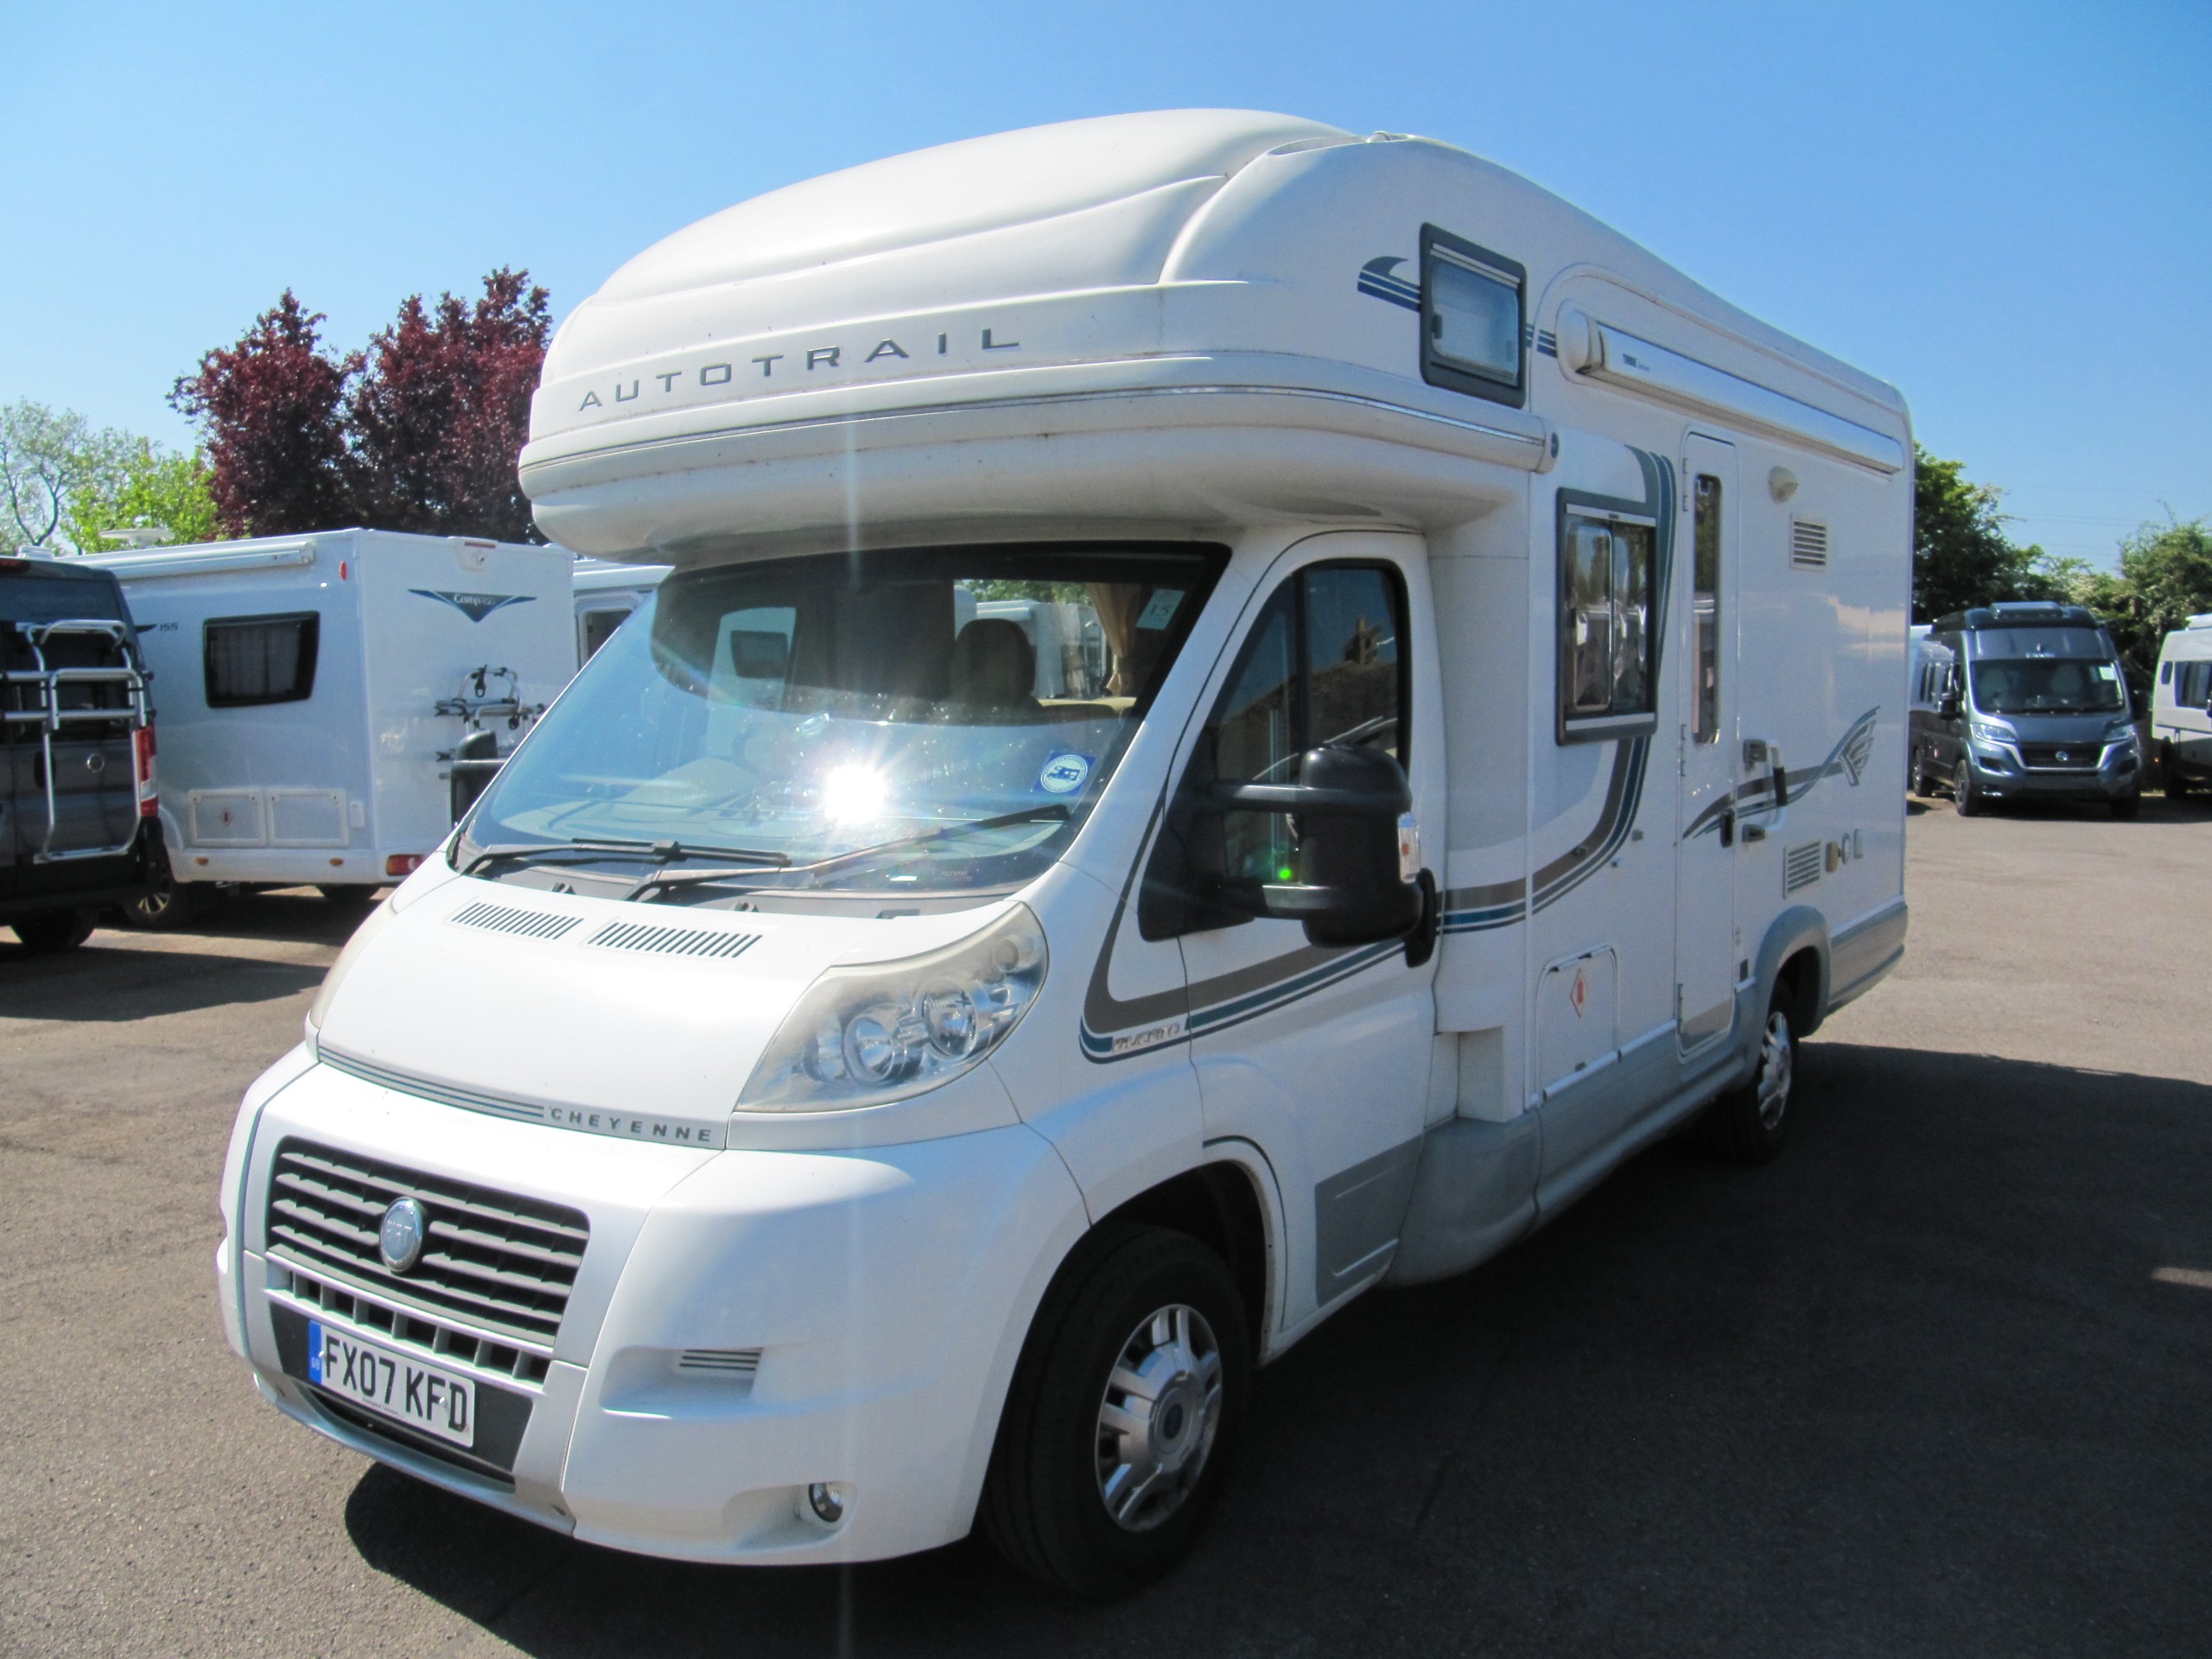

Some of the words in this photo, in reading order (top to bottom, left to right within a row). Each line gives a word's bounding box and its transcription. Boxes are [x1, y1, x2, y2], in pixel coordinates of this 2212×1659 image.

[579, 327, 1020, 411] AUTOTRAIL
[550, 1107, 712, 1142] CHEYENNE
[326, 1334, 396, 1404] FX07
[406, 1366, 467, 1433] KFD
